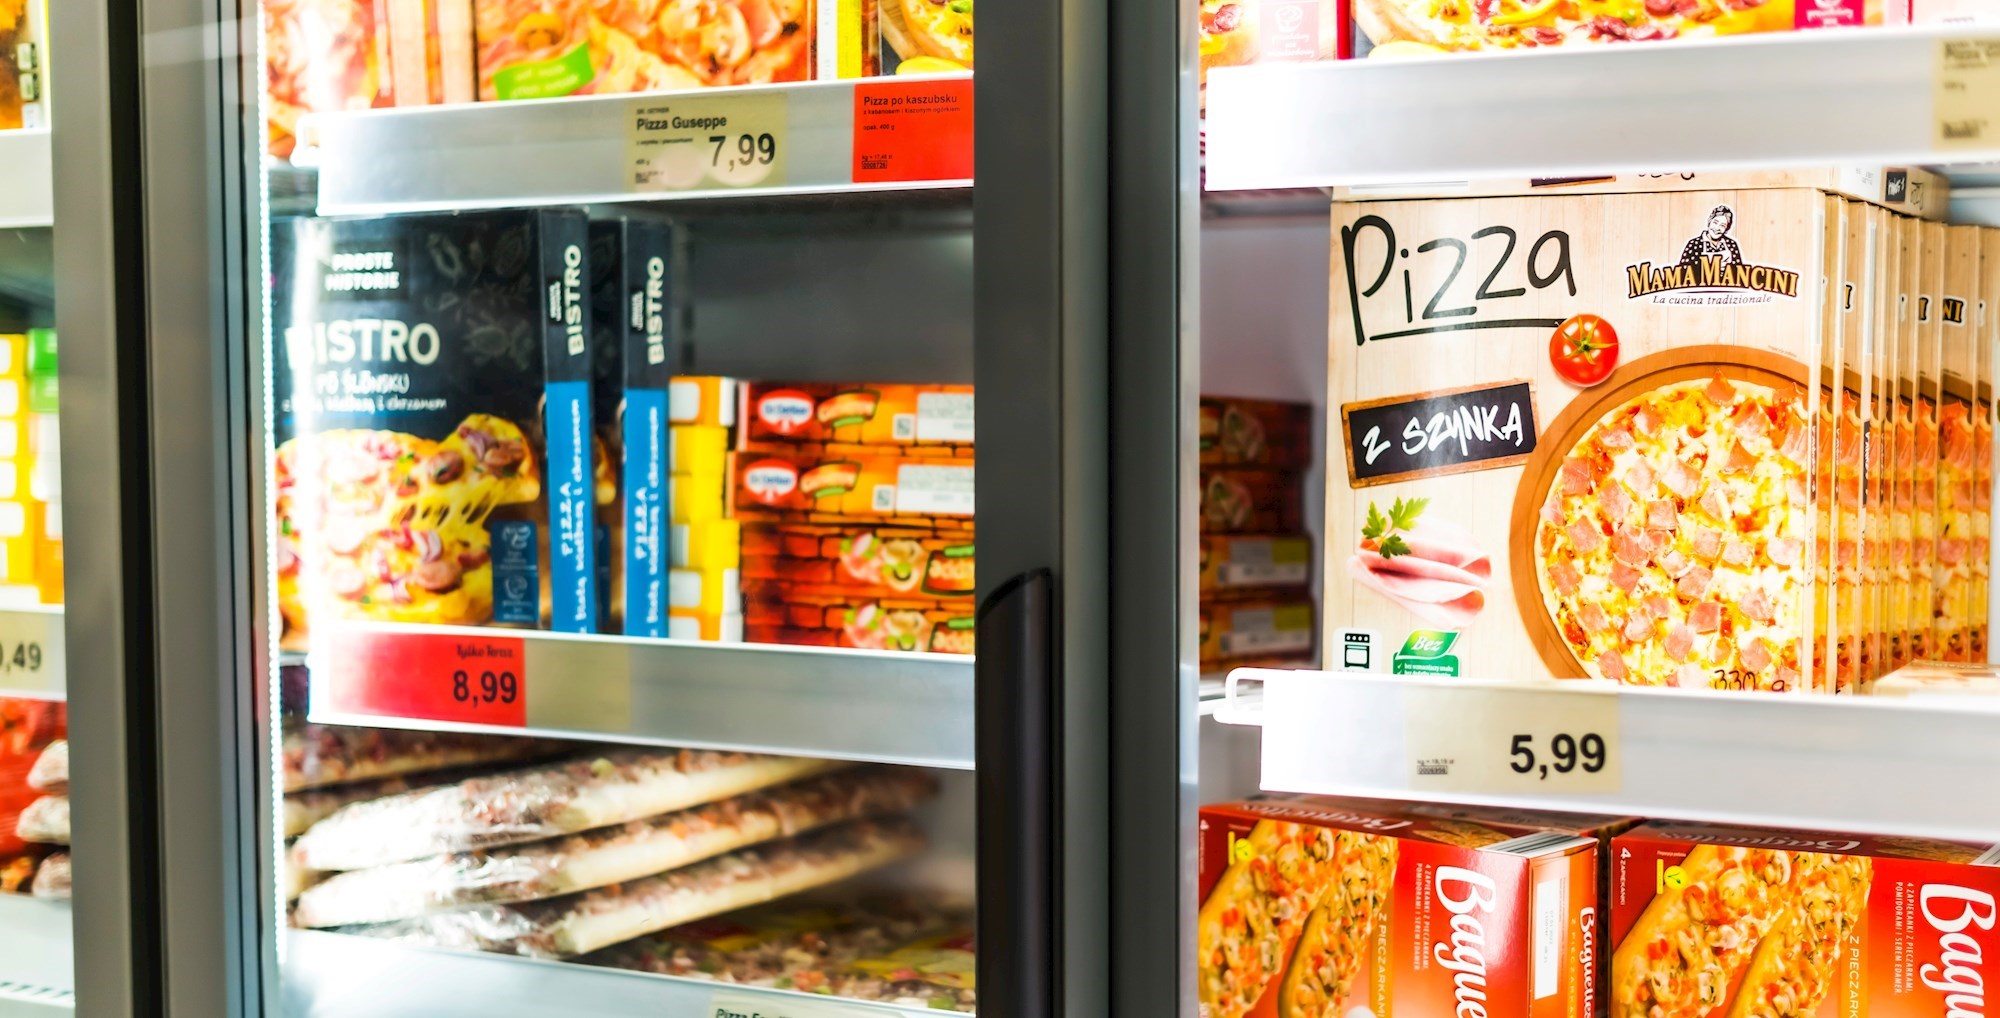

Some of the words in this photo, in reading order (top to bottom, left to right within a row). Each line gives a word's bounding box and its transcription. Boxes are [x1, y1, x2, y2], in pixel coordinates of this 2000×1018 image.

[864, 96, 888, 106] Pizza
[891, 97, 903, 107] po
[906, 94, 957, 104] kaszubsku
[636, 118, 668, 130] Pizza
[672, 116, 727, 130] Guseppe
[709, 133, 775, 172] 7,99
[332, 252, 394, 271] PROSTE
[1341, 215, 1577, 346] Pizza
[1627, 261, 1697, 299] MAMA
[1699, 254, 1800, 298] MANCINI
[325, 272, 399, 291] HISTORIE
[564, 245, 585, 356] BISTRO
[1652, 295, 1666, 304] La
[1668, 296, 1703, 304] cucina
[1708, 294, 1772, 305] tradizionale
[646, 256, 665, 365] BISTRO
[560, 482, 573, 556] PIZZA
[635, 487, 648, 560] PIZZA
[1410, 636, 1444, 652] Bez
[453, 670, 517, 708] 8,99
[1509, 733, 1606, 780] 5,99
[1620, 848, 1632, 859] 4
[1415, 862, 1423, 910] POMIDORAMI
[1378, 912, 1387, 922] Z
[1895, 882, 1904, 930] POMIDORAMI
[1906, 890, 1914, 933] ZAPIEKANKI
[1414, 916, 1422, 940] SEREM
[1850, 936, 1860, 944] Z
[1894, 937, 1903, 964] SEREM
[1378, 924, 1387, 1018] PIECZARKAMI
